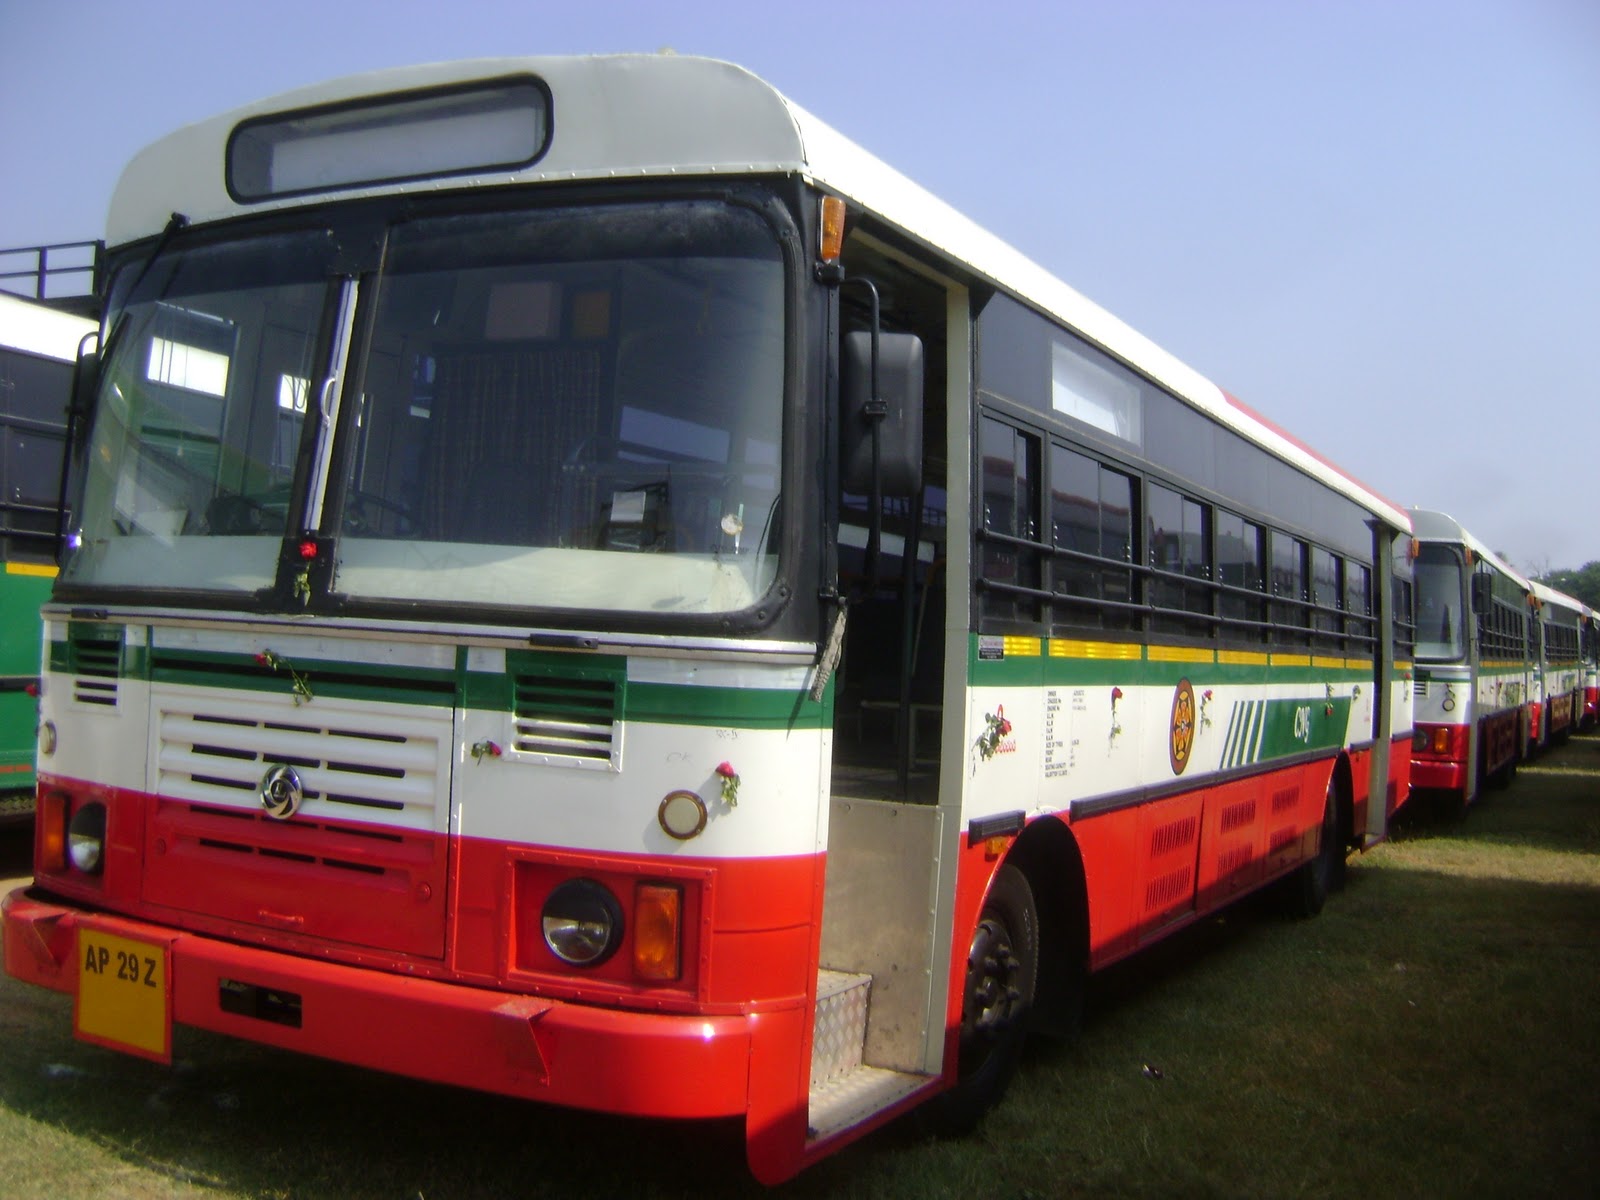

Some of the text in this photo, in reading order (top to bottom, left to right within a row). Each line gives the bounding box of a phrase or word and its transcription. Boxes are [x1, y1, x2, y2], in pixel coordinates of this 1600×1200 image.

[1294, 706, 1311, 744] CNG
[85, 944, 157, 988] AP 29 Z
